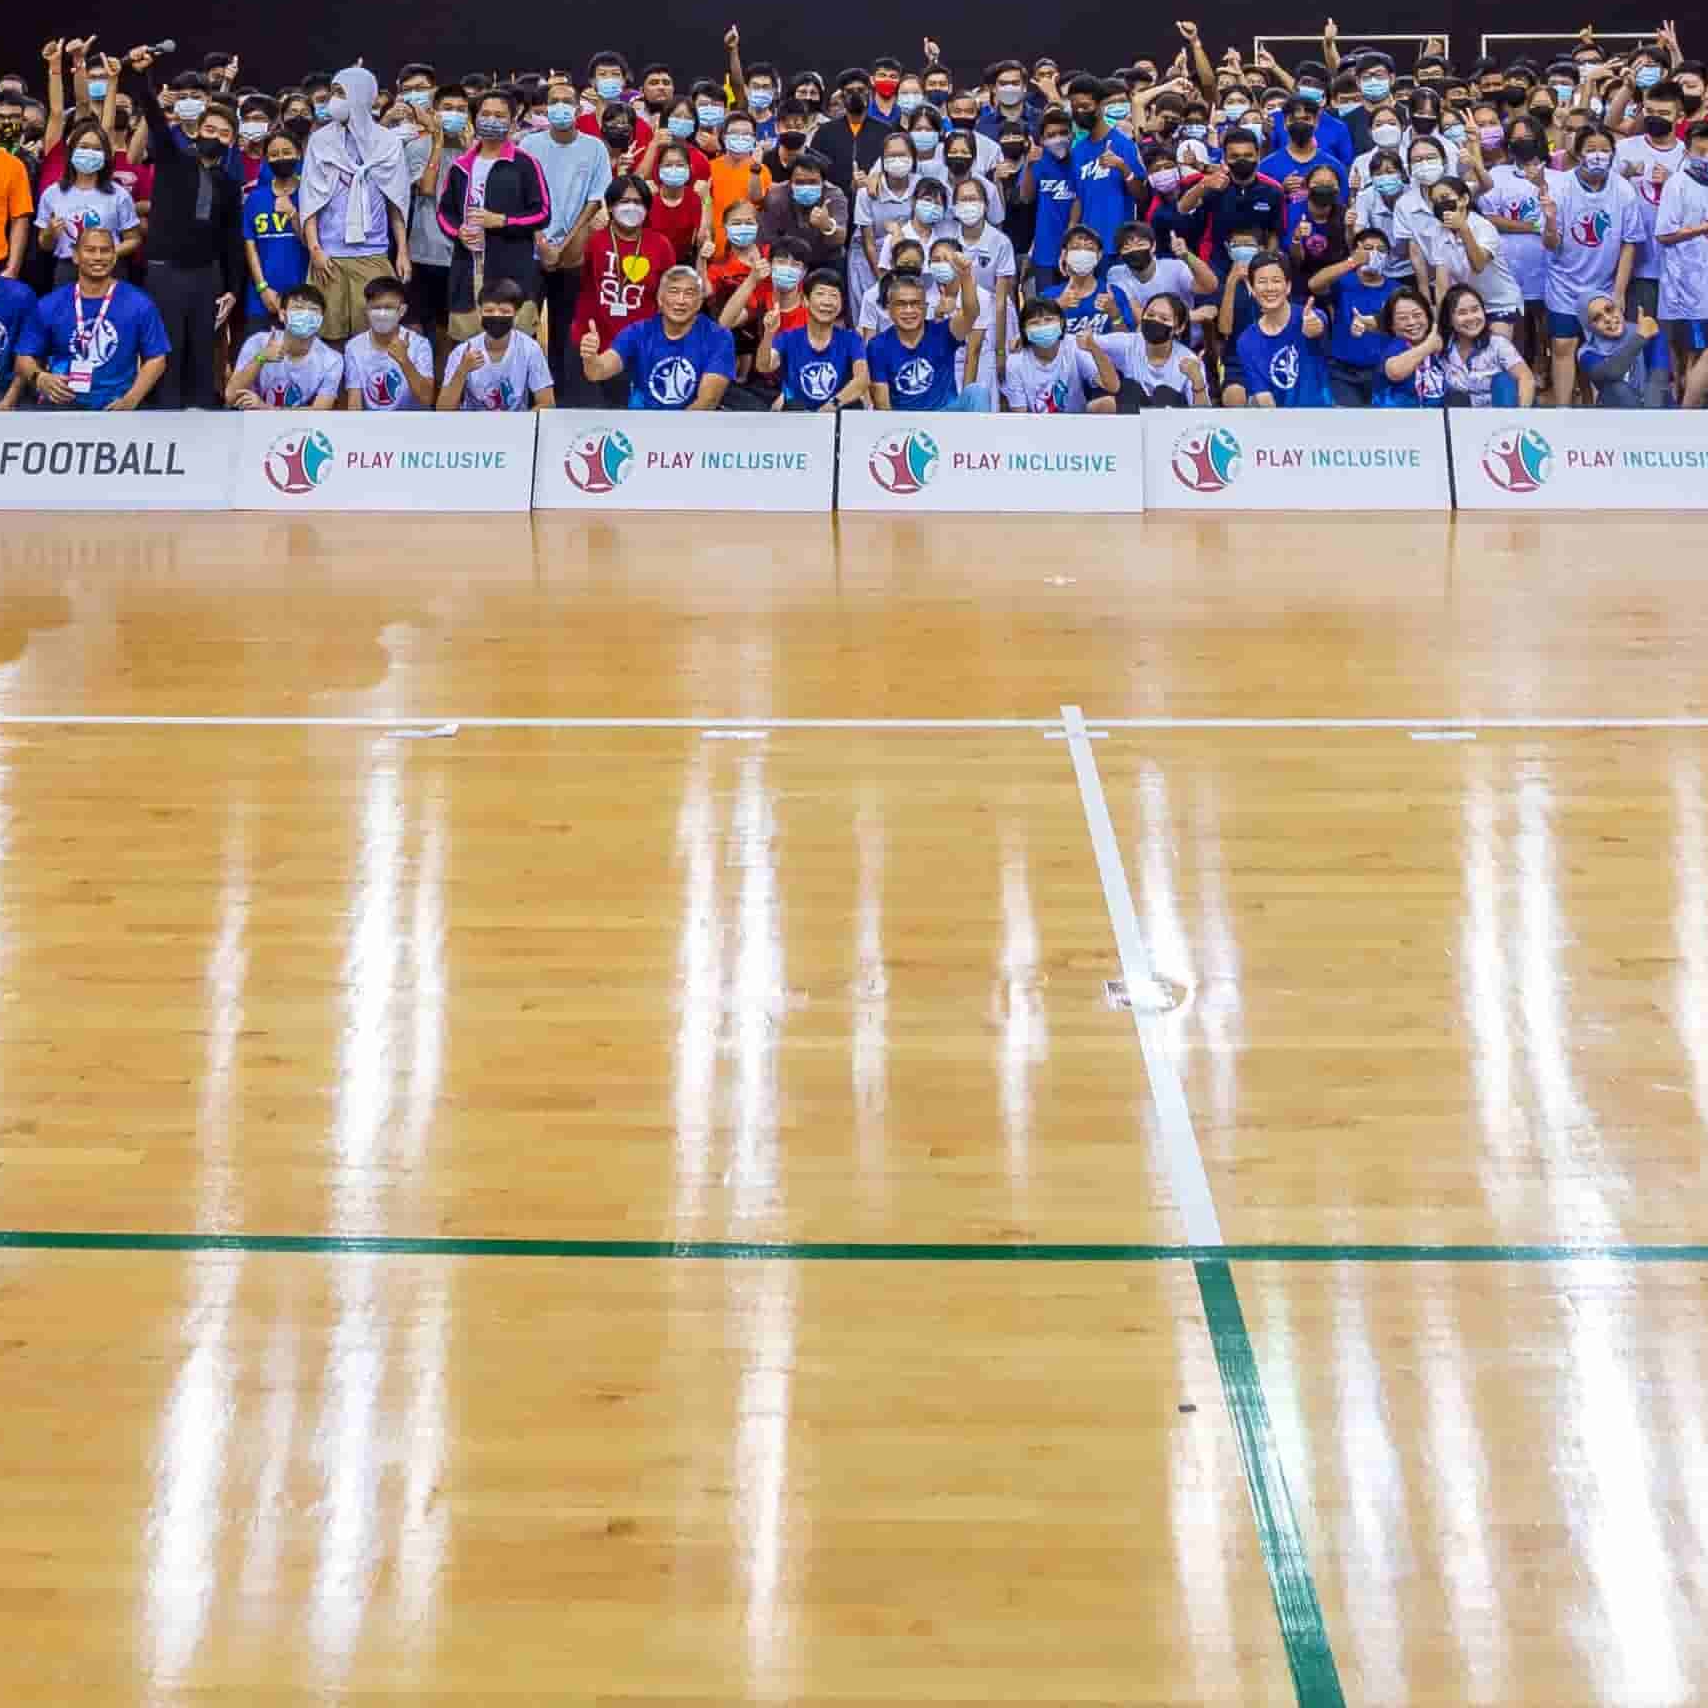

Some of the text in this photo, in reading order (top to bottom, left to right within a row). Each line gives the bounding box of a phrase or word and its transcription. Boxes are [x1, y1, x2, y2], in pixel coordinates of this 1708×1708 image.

[347, 451, 507, 470] PLAY INCLUSIVE
[646, 451, 808, 471] PLAY INCLUSIVE
[953, 452, 1117, 472] PLAY INCLUSIVE
[1255, 448, 1421, 468] PLAY INCLUSIVE
[1566, 449, 1616, 468] PLAY
